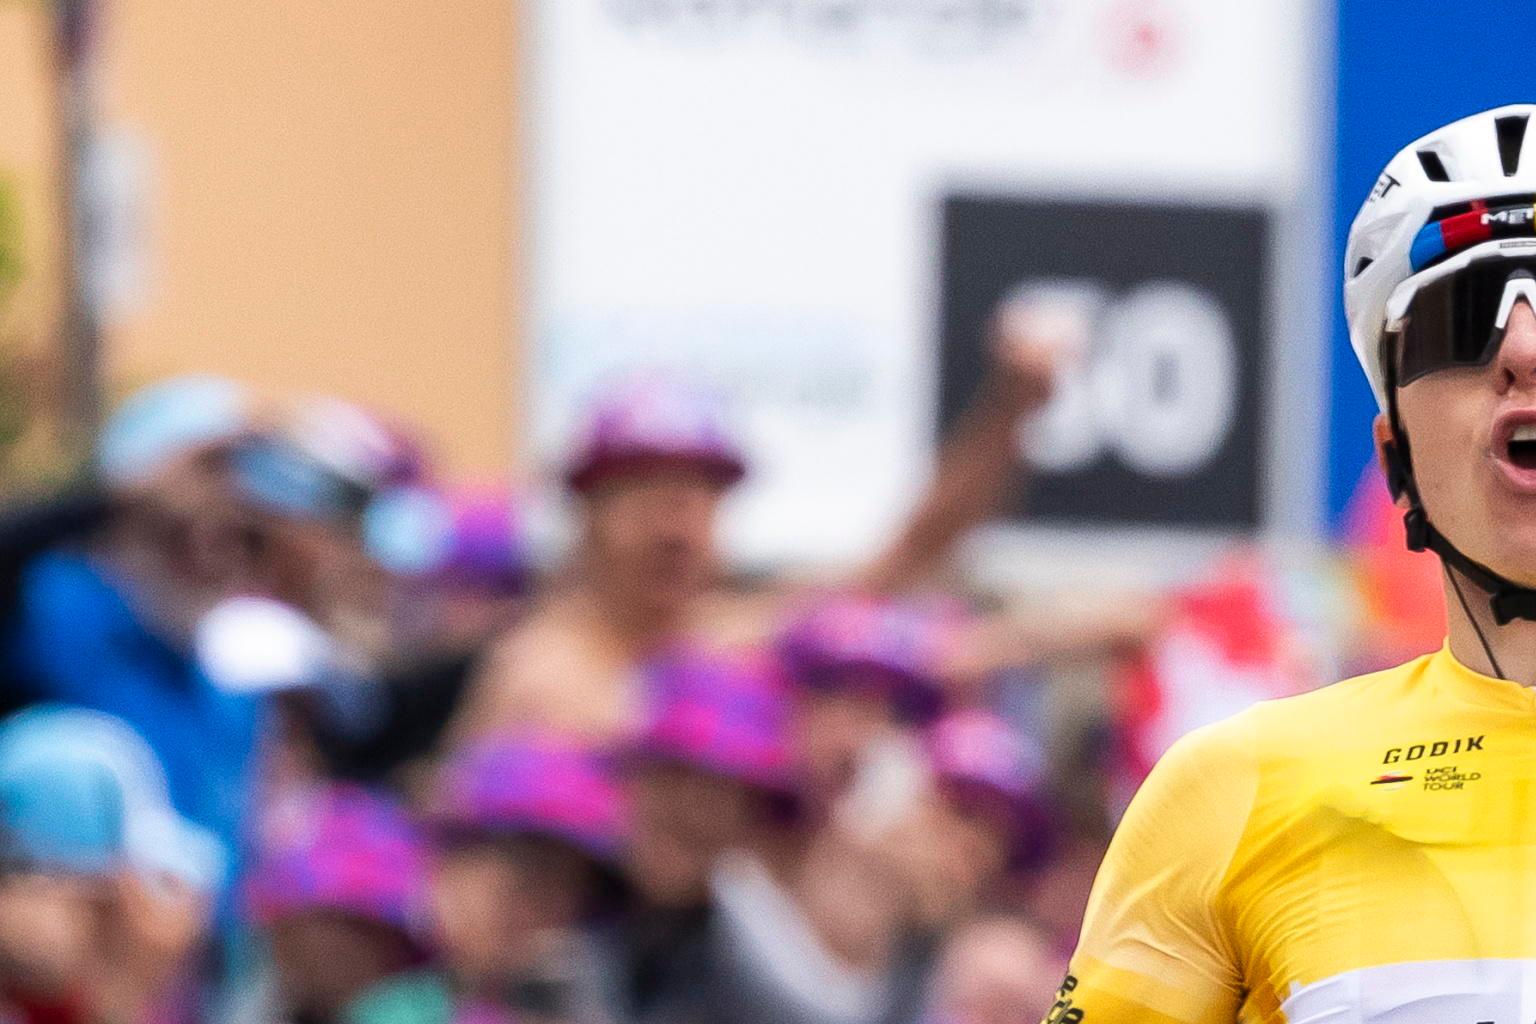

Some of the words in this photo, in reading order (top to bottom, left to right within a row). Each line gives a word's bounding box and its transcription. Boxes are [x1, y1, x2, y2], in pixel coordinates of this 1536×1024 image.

[1480, 207, 1536, 225] MET
[1382, 735, 1486, 764] GODIK
[1424, 772, 1481, 782] WORLD
[1424, 781, 1464, 791] TOUR
